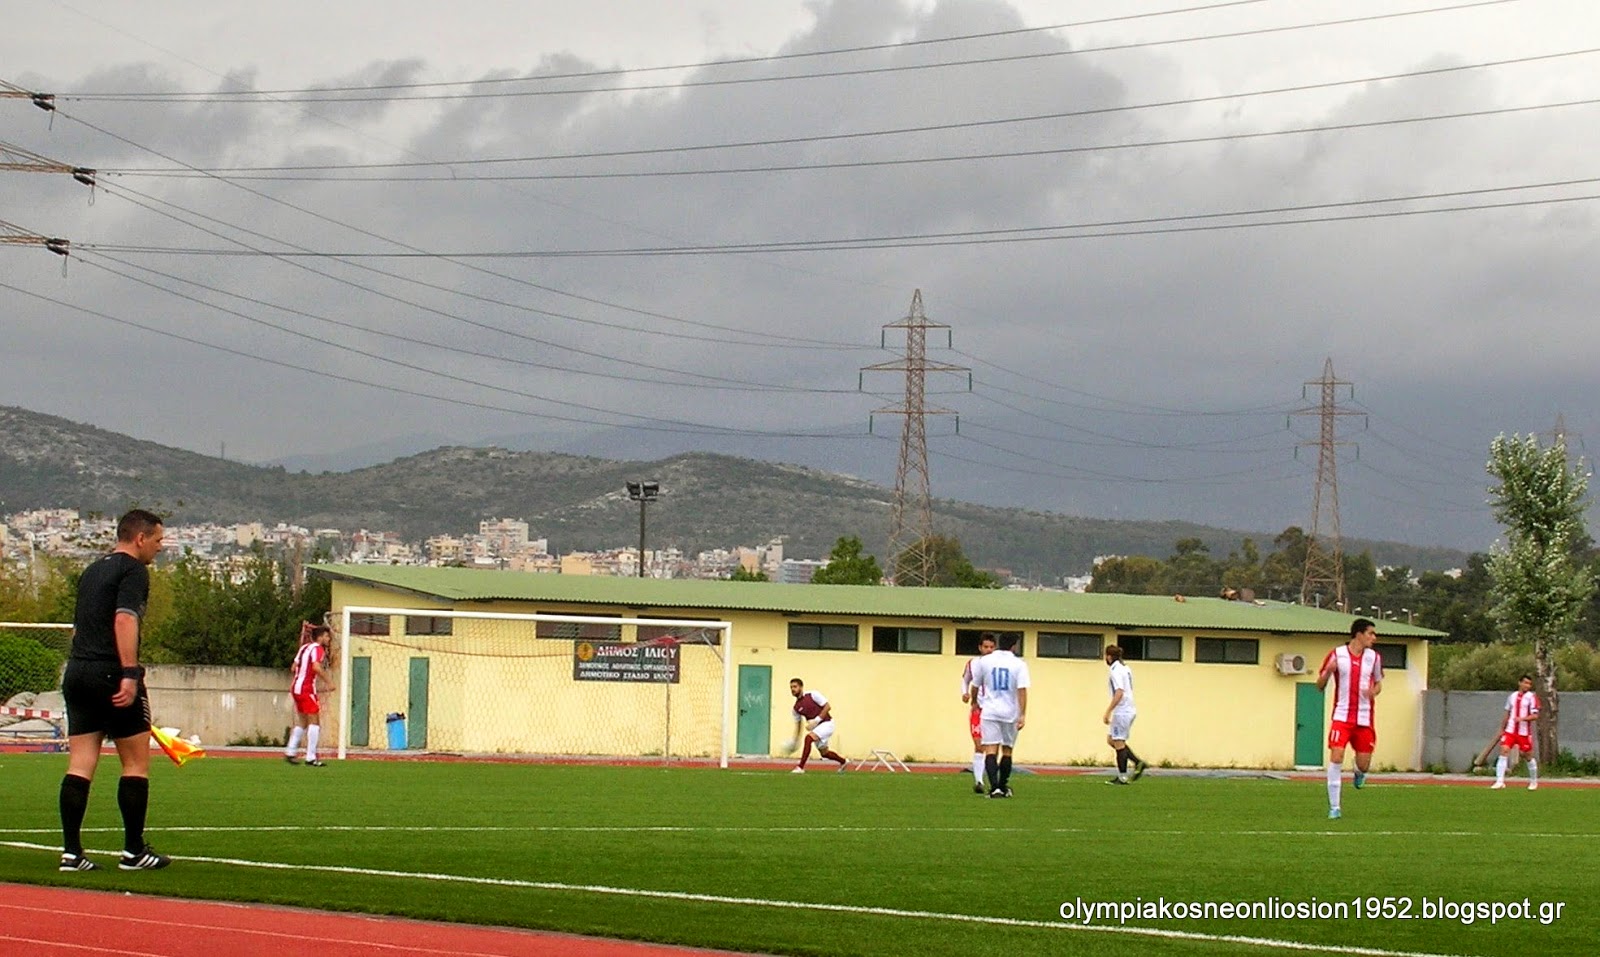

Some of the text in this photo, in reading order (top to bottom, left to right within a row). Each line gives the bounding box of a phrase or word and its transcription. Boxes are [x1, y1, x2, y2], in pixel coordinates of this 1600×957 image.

[597, 646, 677, 658] ΔΗΜΟΣ ΙΛΙΟΥ
[991, 667, 1009, 691] 10
[1330, 729, 1340, 742] 11
